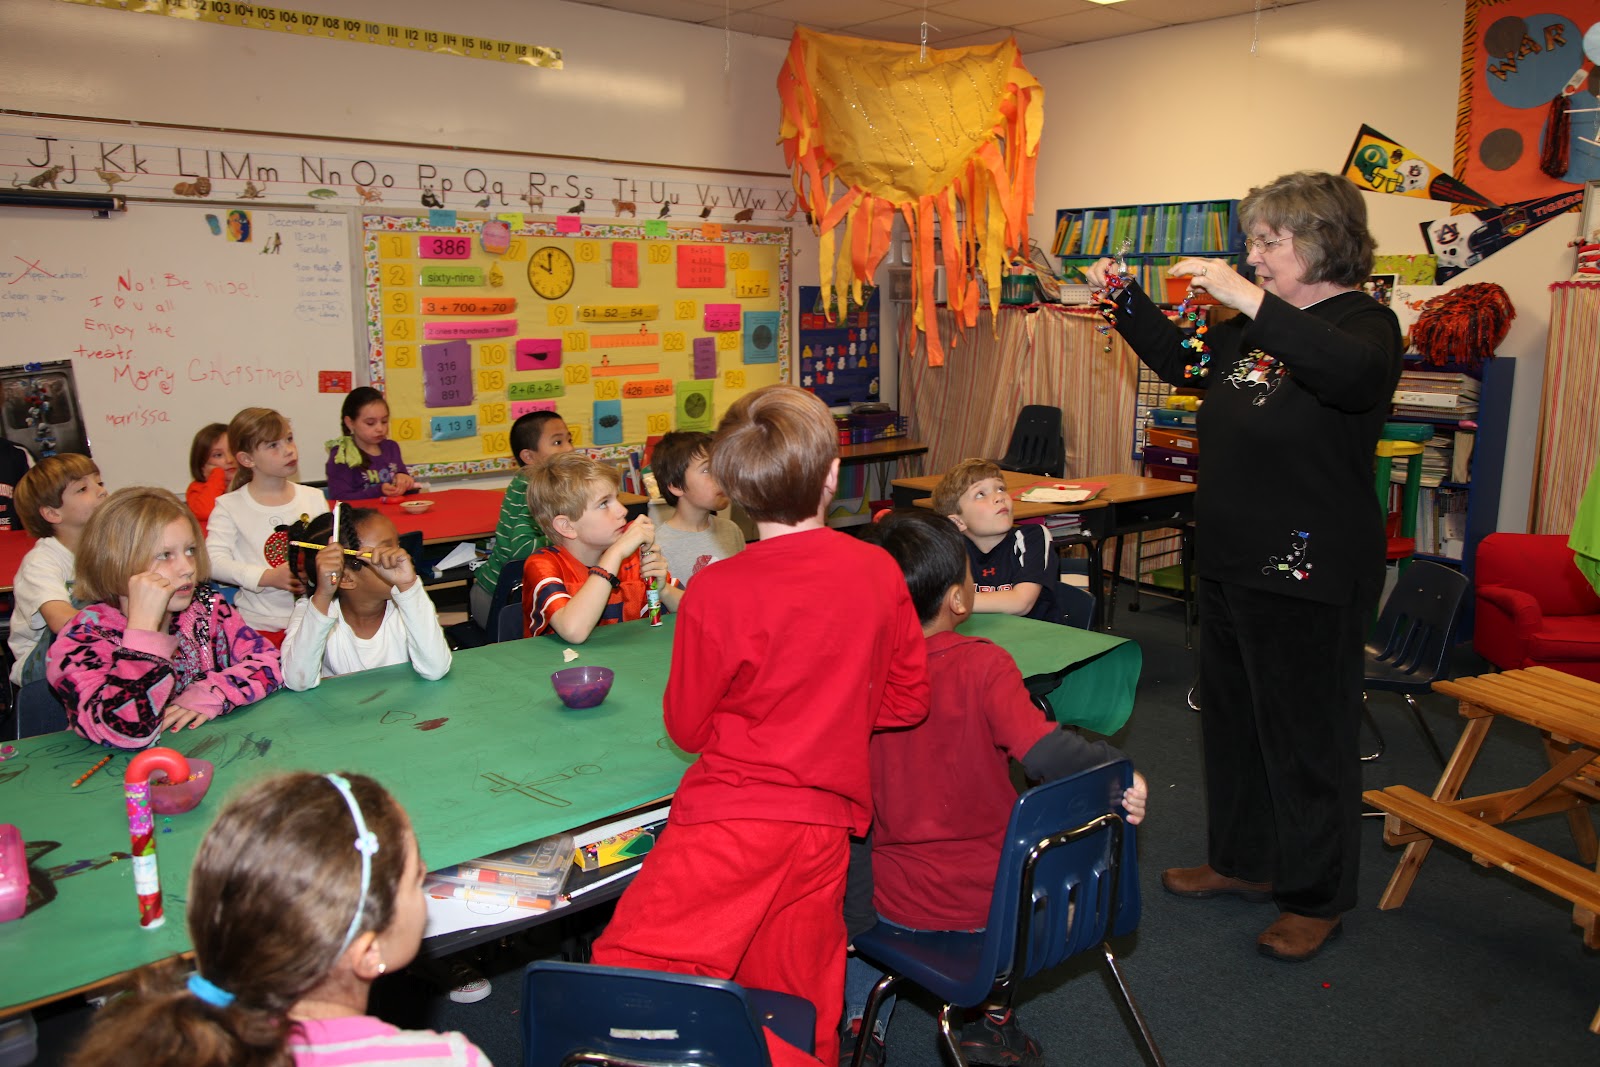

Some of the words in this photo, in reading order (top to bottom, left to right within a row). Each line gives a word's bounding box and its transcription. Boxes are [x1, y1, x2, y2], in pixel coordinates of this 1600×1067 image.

[211, 1, 231, 14] 103
[234, 3, 253, 17] 104
[257, 7, 276, 21] 105
[279, 10, 298, 24] 106
[301, 14, 319, 27] 107
[322, 17, 340, 30] 108
[343, 20, 361, 33] 109
[364, 23, 380, 35] 110
[387, 26, 399, 38] 111
[404, 29, 419, 41] 112
[424, 31, 438, 44] 113
[443, 34, 457, 46] 114
[462, 37, 475, 49] 115
[479, 40, 493, 51] 116
[497, 42, 511, 54] 117
[515, 45, 527, 56] 118
[532, 47, 544, 58] 119
[1487, 23, 1568, 82] WAR
[1532, 192, 1585, 217] TIGERS
[390, 236, 402, 257] 1
[432, 239, 466, 256] 386
[508, 240, 523, 260] 7
[580, 243, 595, 262] 8
[650, 245, 670, 263] 19
[729, 252, 748, 270] 20
[164, 272, 193, 291] Be
[389, 264, 406, 286] 2
[427, 271, 476, 284] sixty-nine
[89, 295, 104, 308] I
[155, 300, 175, 314] all
[392, 292, 407, 313] 3
[427, 302, 436, 313] 3
[452, 303, 477, 313] 700
[491, 303, 507, 313] 70
[679, 301, 697, 318] 21
[554, 306, 570, 325] 9
[583, 309, 597, 318] 51
[604, 308, 618, 318] 52
[630, 308, 644, 317] 54
[84, 318, 136, 340] Enjoy
[147, 321, 176, 338] the
[391, 319, 409, 340] 4
[459, 327, 490, 335] hundreds
[709, 319, 721, 328] 25
[568, 332, 588, 351] 11
[664, 333, 685, 351] 22
[718, 332, 738, 350] 23
[394, 346, 411, 367] 5
[480, 344, 506, 365] 10
[437, 361, 457, 373] 316
[565, 365, 588, 384] 12
[439, 375, 458, 387] 137
[480, 370, 505, 391] 13
[725, 371, 746, 388] 24
[441, 389, 460, 400] 891
[595, 380, 618, 399] 14
[626, 385, 643, 396] 426
[654, 384, 670, 394] 624
[480, 404, 506, 424] 15
[648, 414, 669, 432] 18
[399, 420, 415, 440] 6
[434, 423, 442, 433] 4
[448, 421, 461, 432] 13
[465, 419, 473, 430] 9
[482, 433, 508, 453] 16
